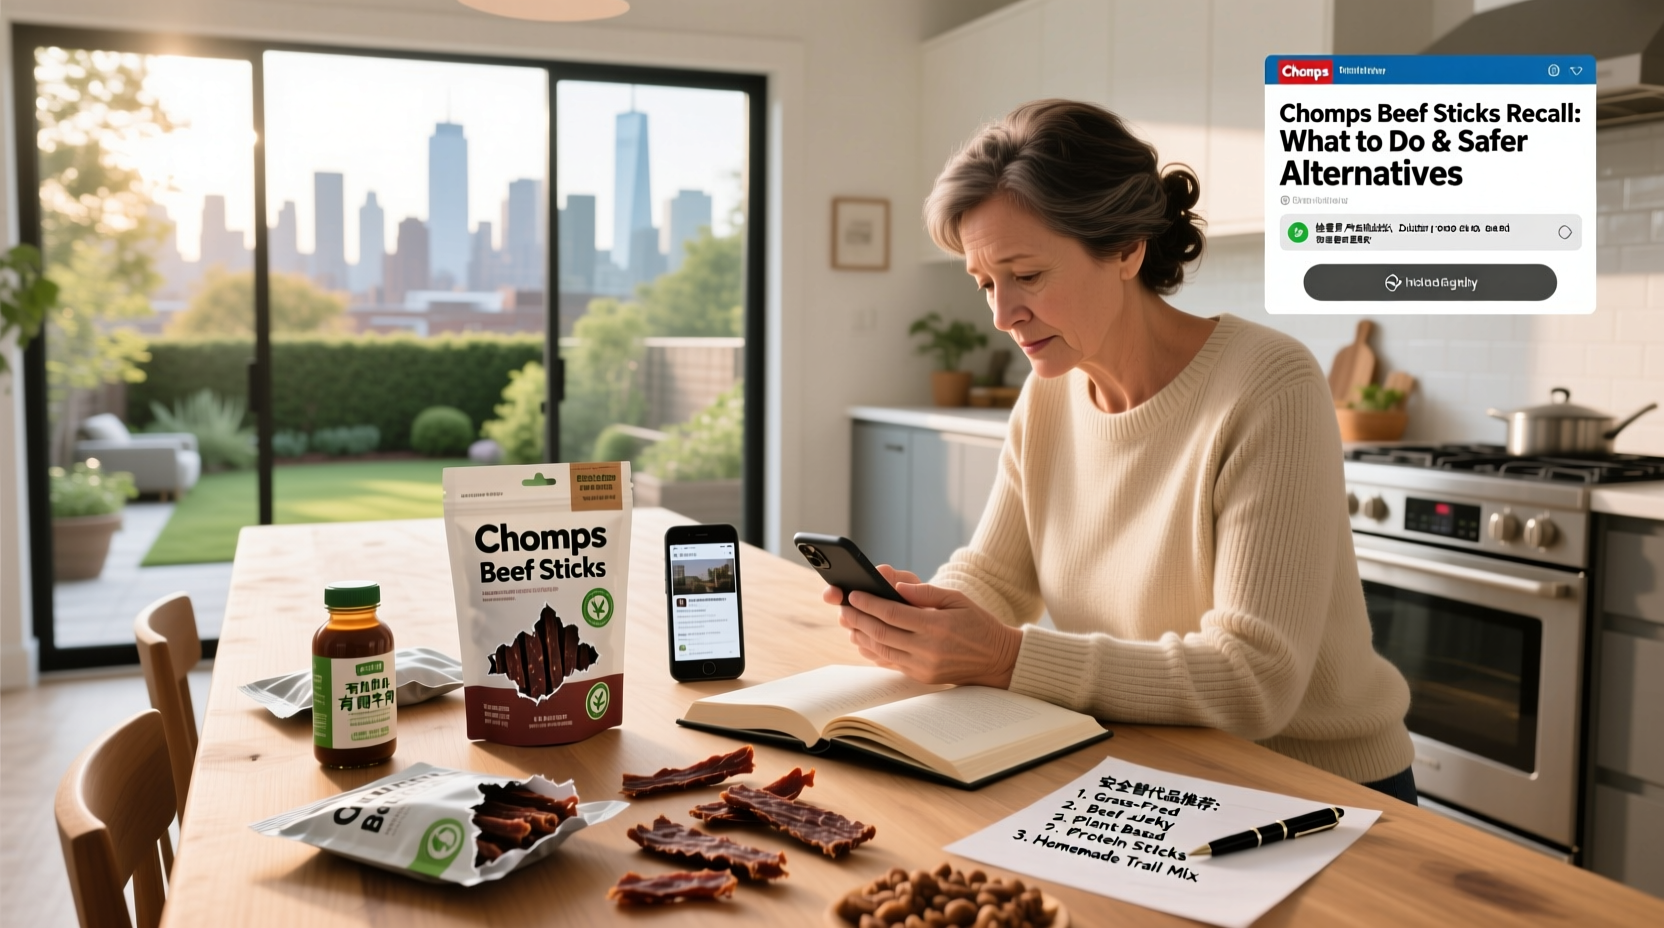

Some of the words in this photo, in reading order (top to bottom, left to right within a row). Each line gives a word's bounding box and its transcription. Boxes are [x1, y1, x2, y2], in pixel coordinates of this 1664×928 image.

[475, 523, 607, 556] Chomps
[480, 558, 535, 583] Beef
[539, 556, 607, 580] Sticks
[1077, 788, 1087, 799] 1.
[1061, 800, 1077, 811] 2.
[1086, 804, 1125, 819] Beef
[1072, 815, 1119, 832] Plant
[1012, 829, 1029, 843] 3.
[1032, 834, 1120, 865] Homemade
[1127, 855, 1164, 873] Trail
[1167, 865, 1200, 883] Mix
[1132, 841, 1187, 861] Sticks
